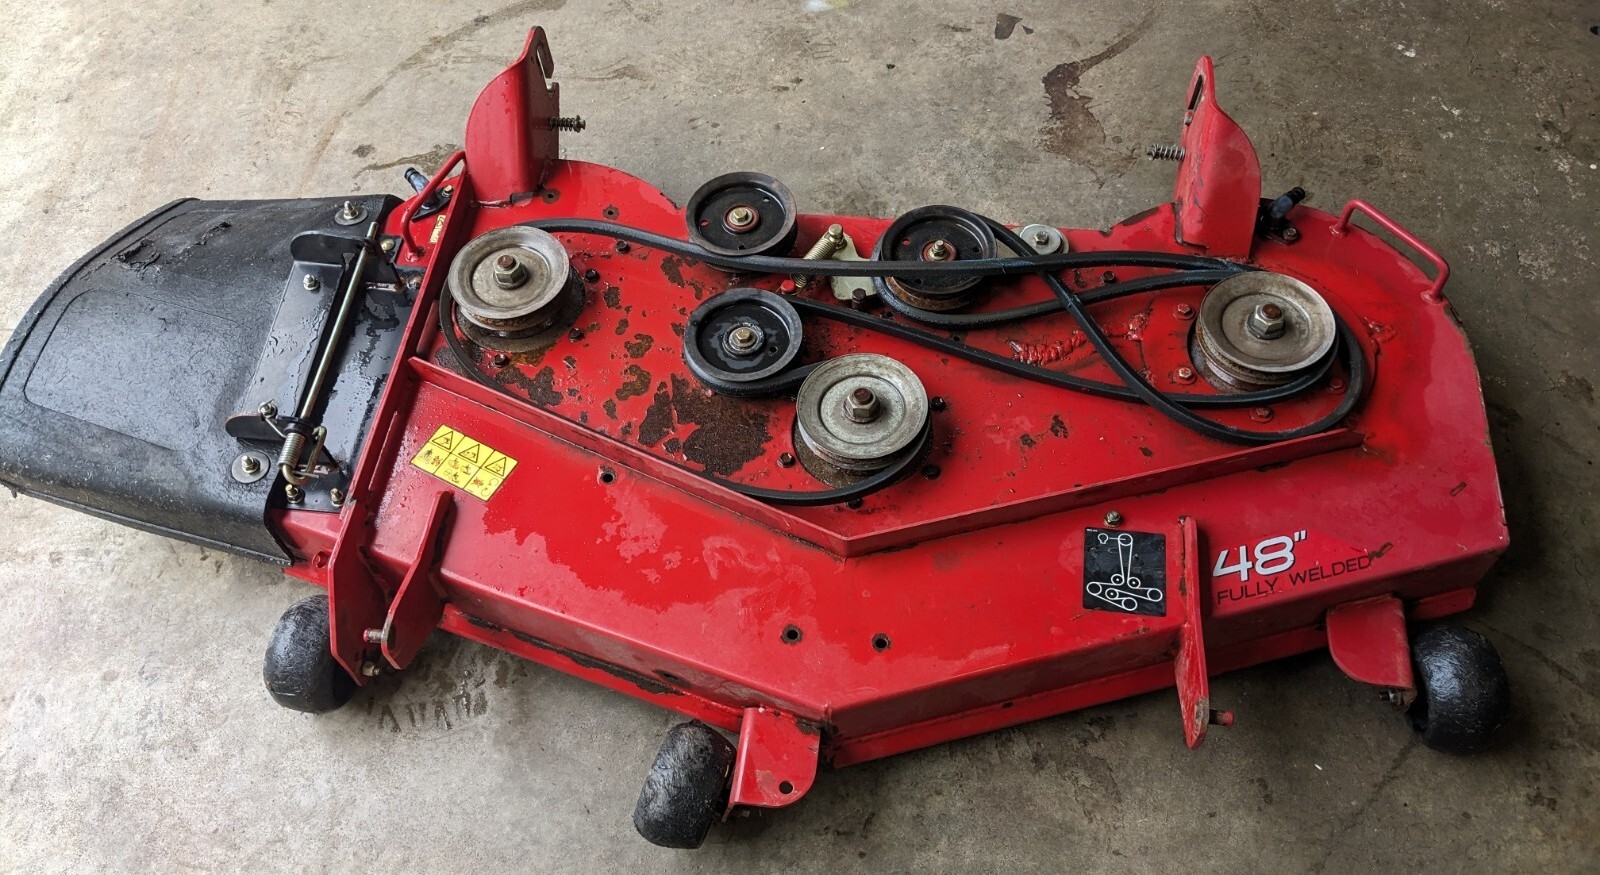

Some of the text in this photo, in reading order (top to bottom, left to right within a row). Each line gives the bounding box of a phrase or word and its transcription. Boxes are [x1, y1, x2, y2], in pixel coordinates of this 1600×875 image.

[1212, 529, 1307, 582] 48"
[1217, 555, 1371, 605] FULLY WELDED
